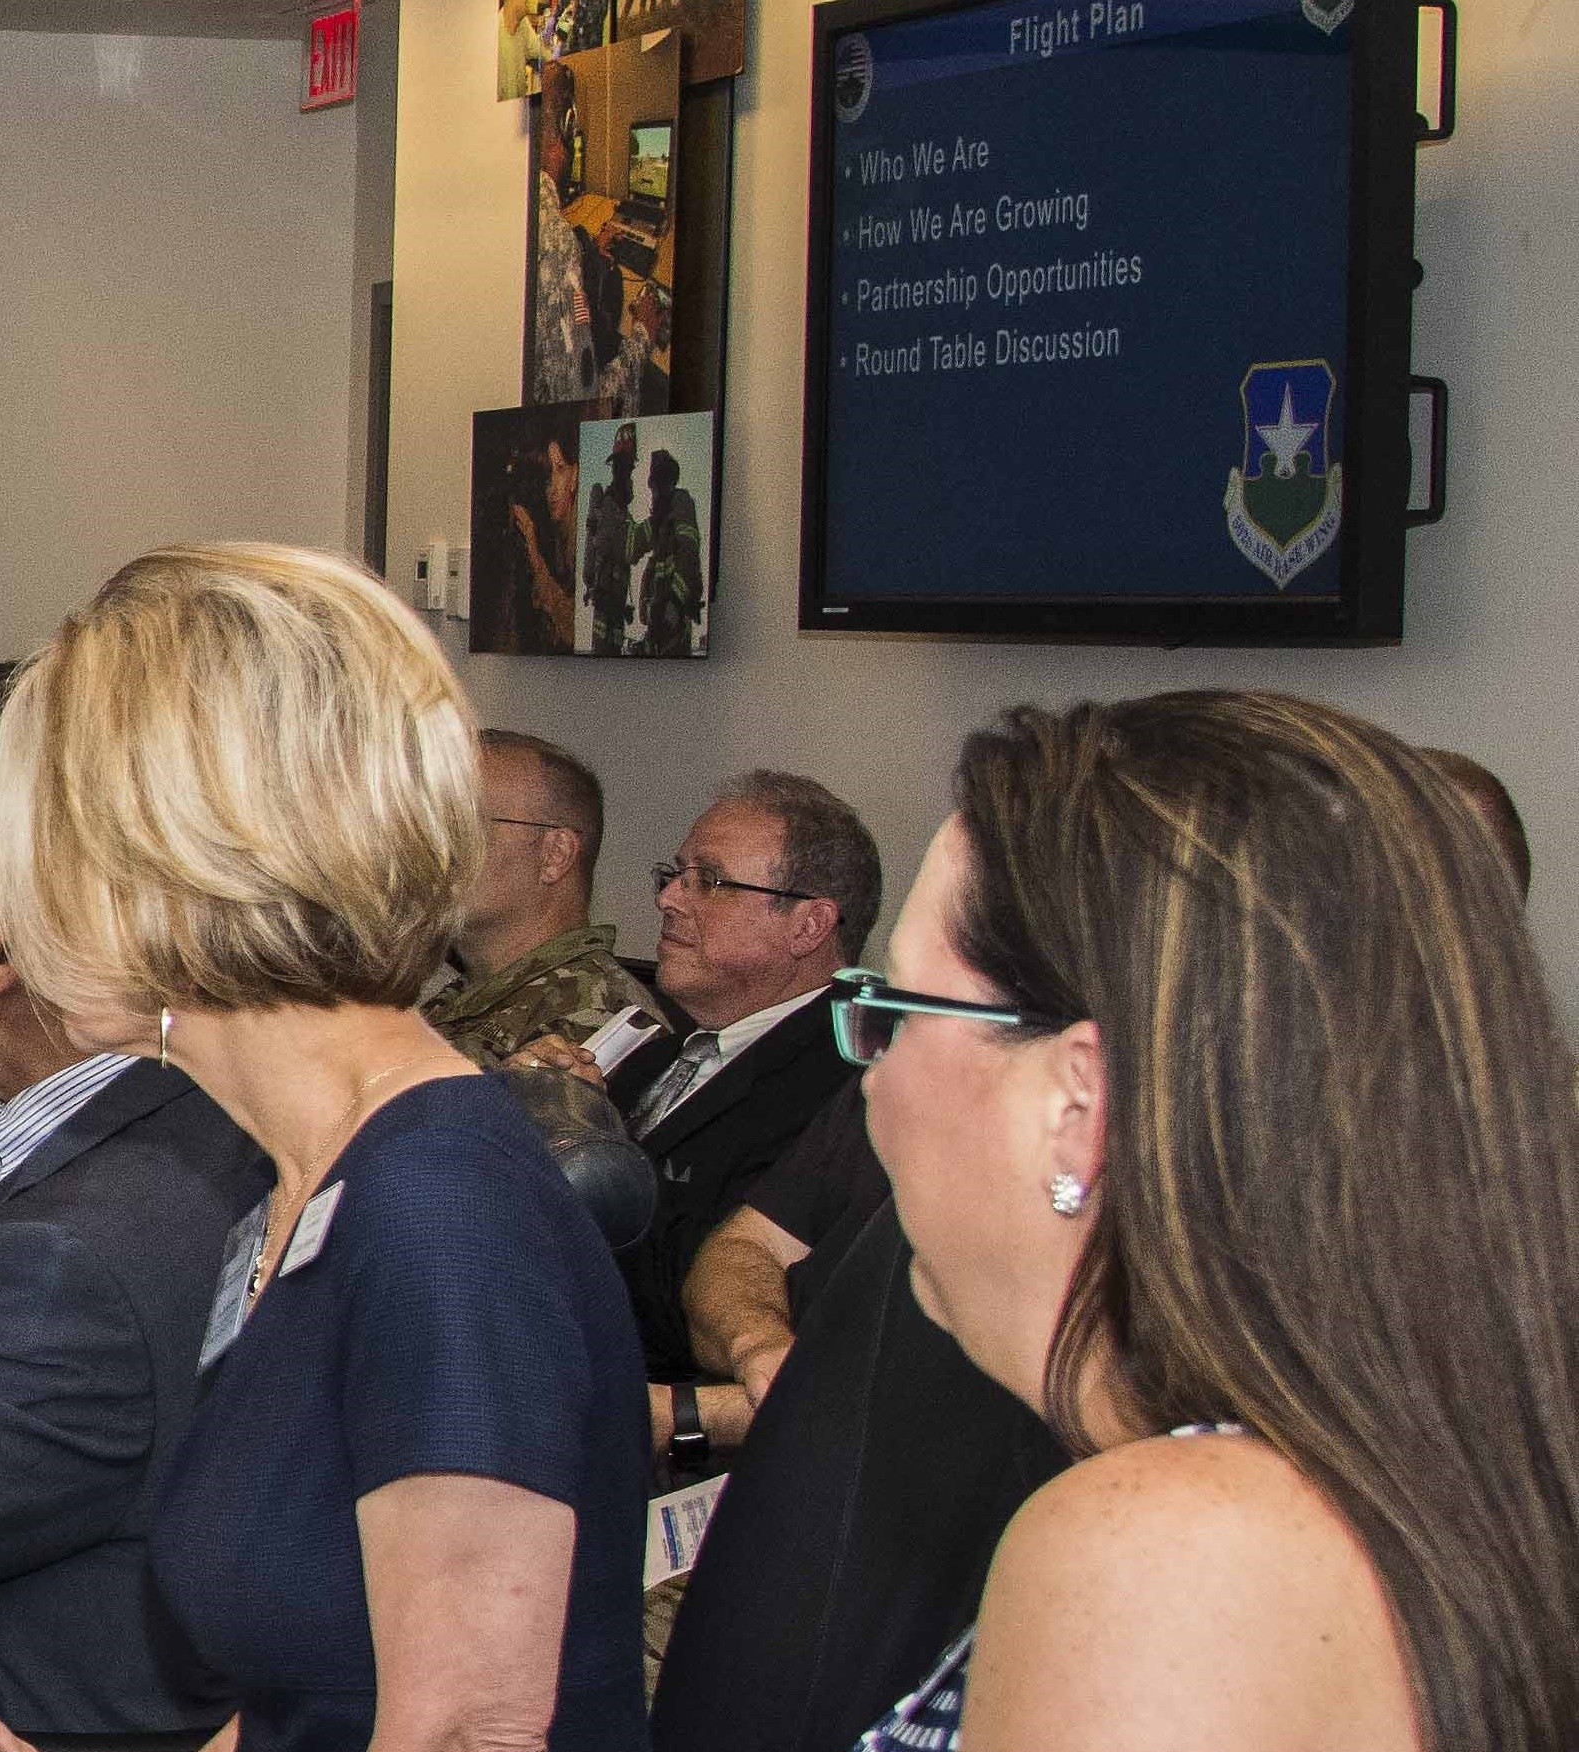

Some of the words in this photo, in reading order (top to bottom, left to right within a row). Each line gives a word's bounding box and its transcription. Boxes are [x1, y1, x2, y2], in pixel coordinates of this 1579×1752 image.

[1009, 9, 1080, 59] Flight
[1090, 1, 1144, 39] Plan
[859, 150, 905, 186] Who
[912, 141, 945, 178] We
[952, 136, 990, 172] Are
[857, 214, 902, 250] How
[910, 206, 943, 242] We
[950, 201, 986, 238] Are
[996, 187, 1089, 231] Growing
[857, 266, 978, 312] Partnership
[986, 250, 1143, 305] Opportunities
[855, 338, 921, 377] Round
[929, 334, 986, 371] Table
[995, 321, 1121, 366] Discussion
